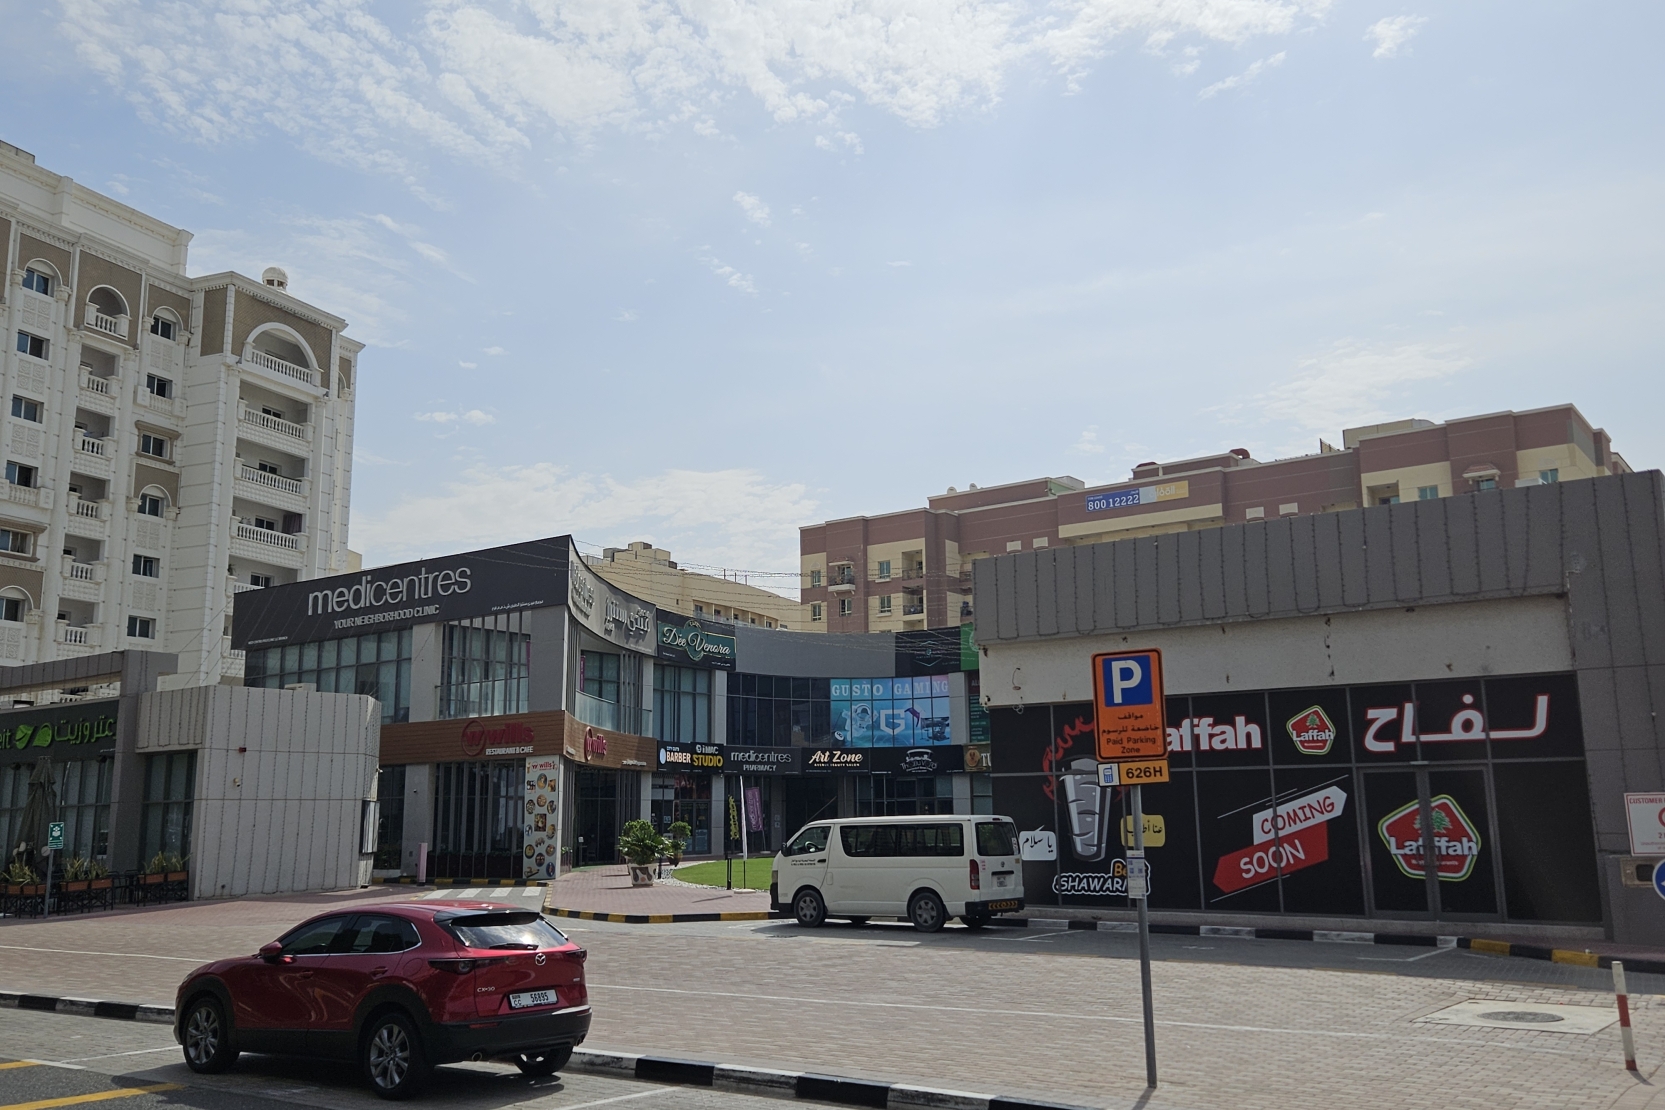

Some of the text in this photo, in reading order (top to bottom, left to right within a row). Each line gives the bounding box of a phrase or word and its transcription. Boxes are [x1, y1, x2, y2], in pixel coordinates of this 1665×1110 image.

[1087, 494, 1139, 511] 800 12222
[307, 567, 472, 616] medicentres
[333, 604, 440, 630] YOUR NEIGHBORHOOD CLINIC
[663, 627, 731, 656] Dee Venora
[831, 680, 949, 697] GUSTO GAMING
[1111, 659, 1143, 704] P
[1117, 711, 1144, 721] مواقف
[1364, 694, 1550, 752] لفاح
[91, 714, 118, 743] عتر
[486, 721, 535, 745] wills
[1101, 725, 1160, 736] خاضعة للرسوم
[1166, 715, 1263, 752] affah
[1292, 729, 1334, 741] Laffah
[1106, 736, 1157, 746] Paid Parking
[666, 751, 692, 764] BARBER
[730, 750, 792, 763] medicentres
[808, 750, 864, 764] Art Zone
[1120, 746, 1141, 754] Zone
[692, 754, 724, 767] STUDIO
[743, 764, 777, 772] PHARMACY
[1125, 765, 1163, 779] 626H
[1259, 795, 1336, 836] COMING
[1239, 838, 1306, 880] SOON
[1056, 876, 1130, 892] SHAWAR
